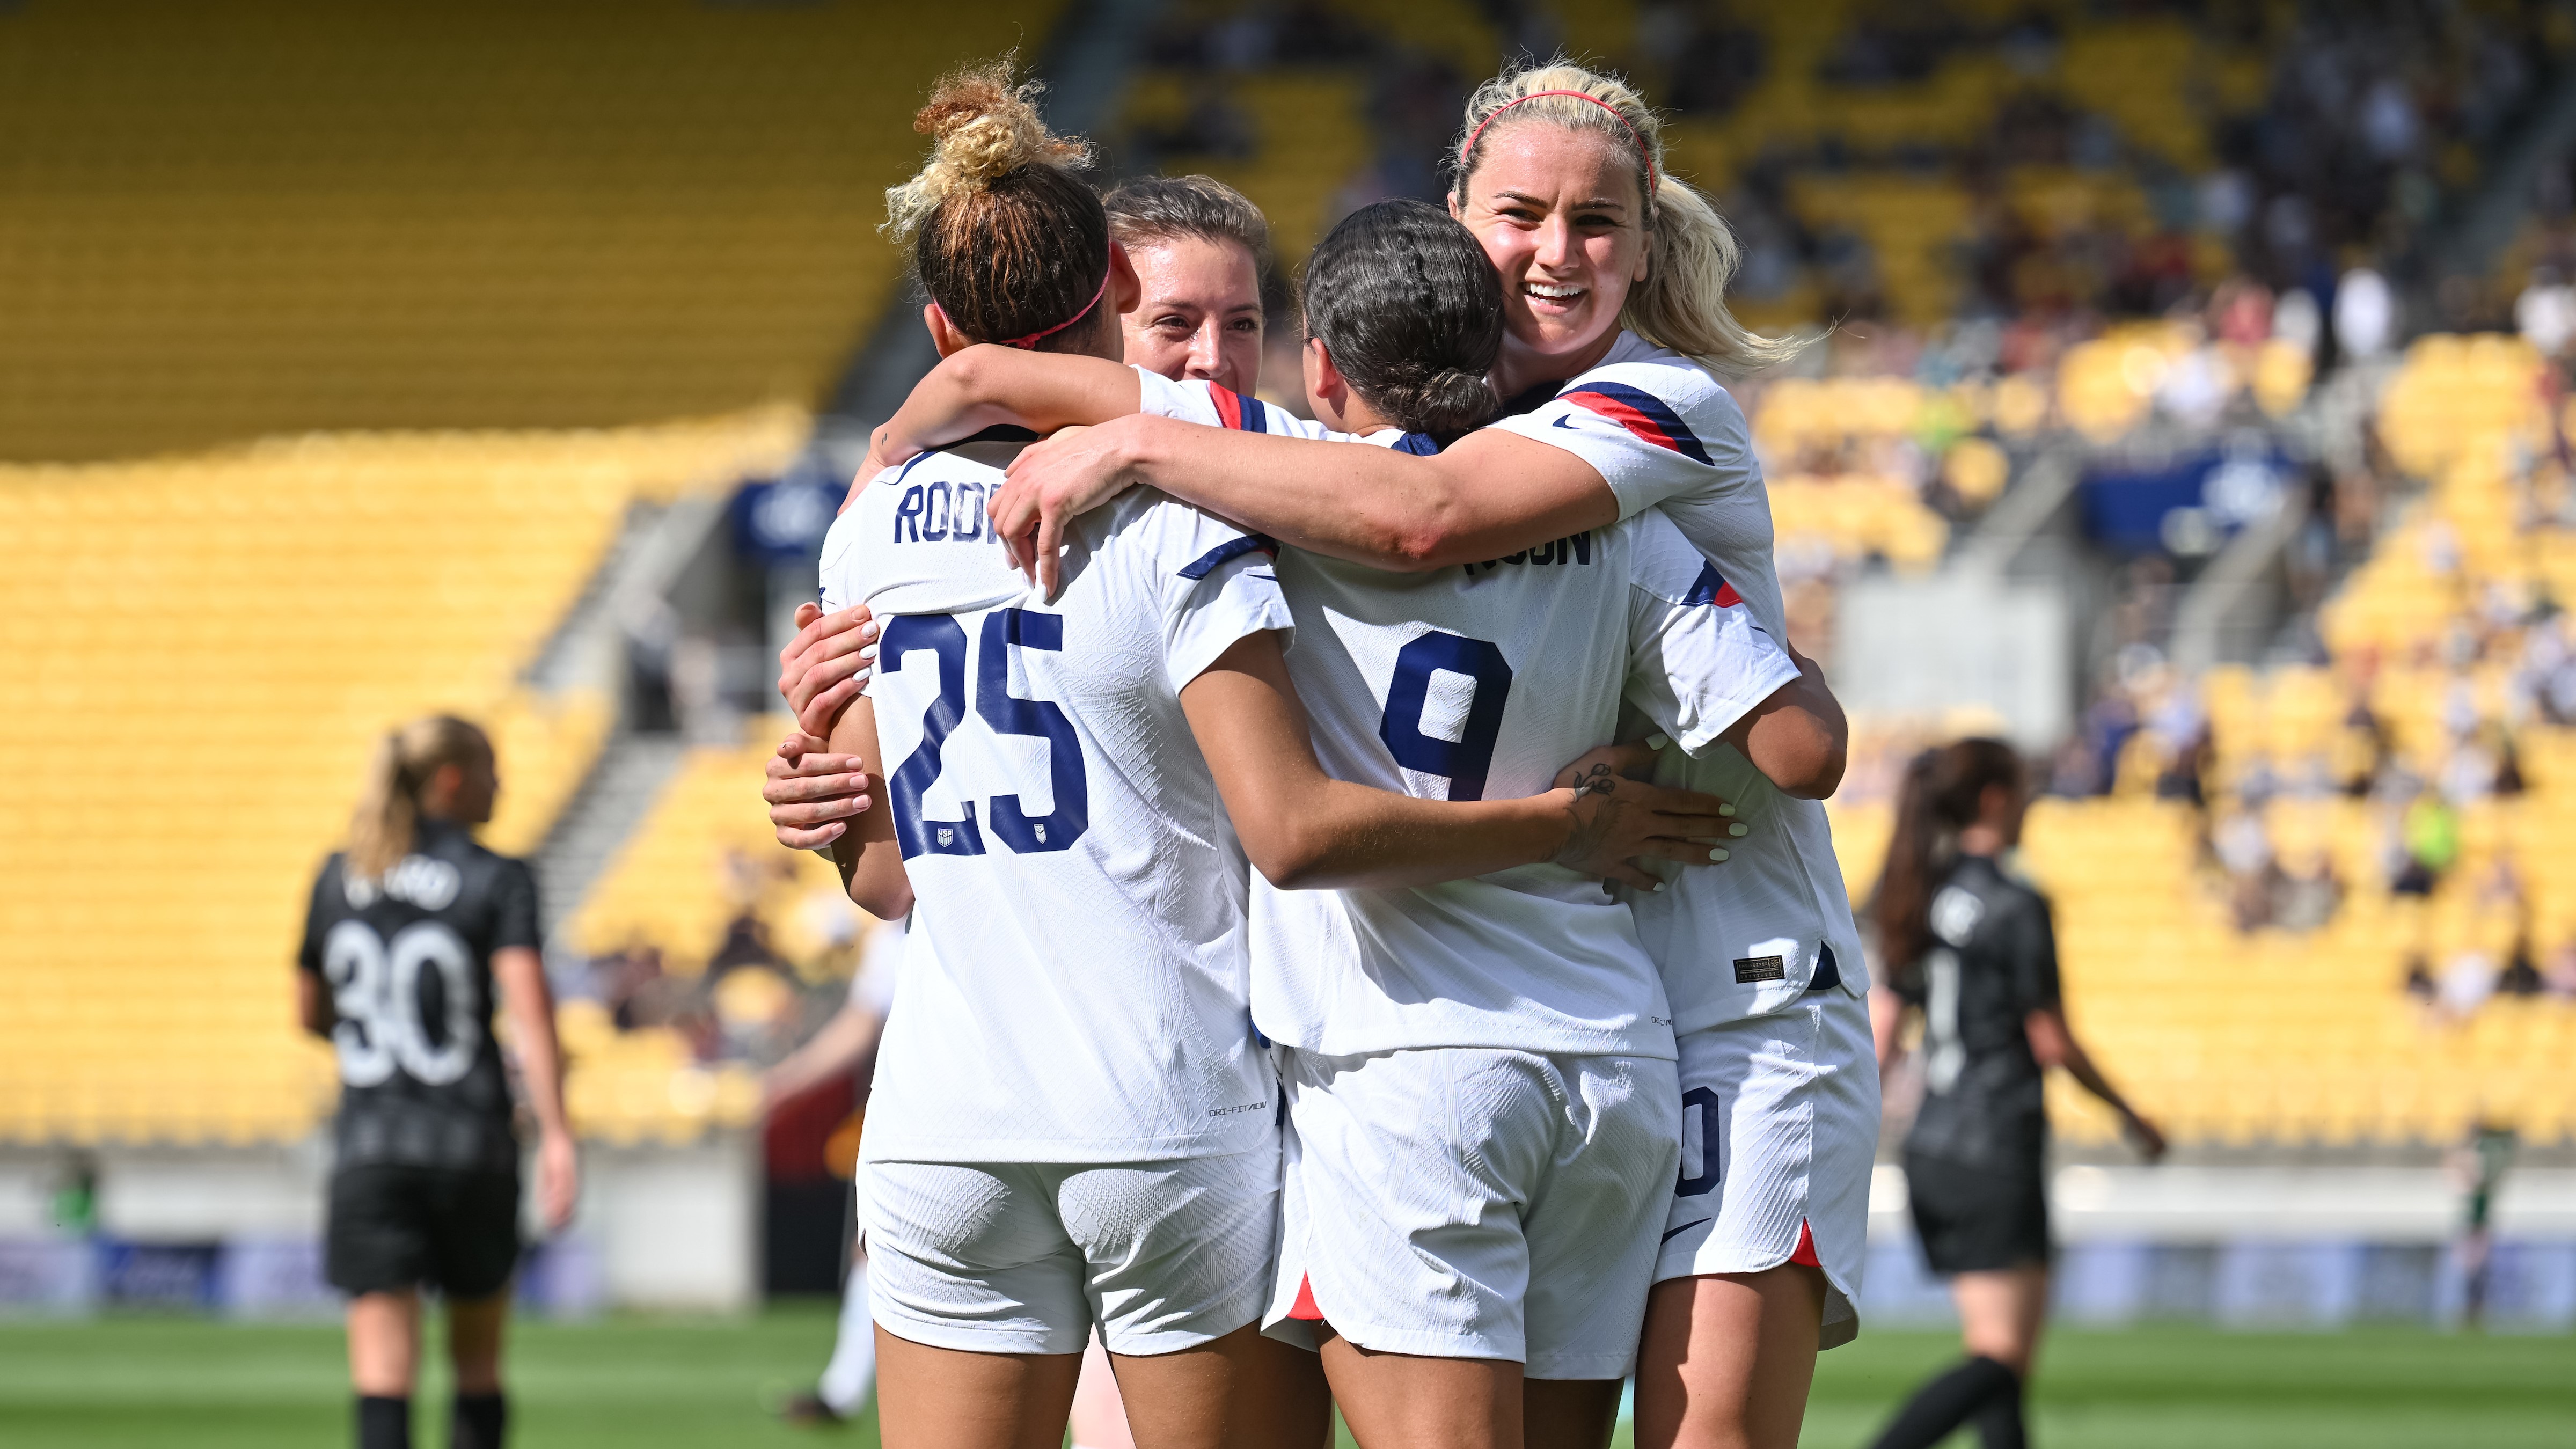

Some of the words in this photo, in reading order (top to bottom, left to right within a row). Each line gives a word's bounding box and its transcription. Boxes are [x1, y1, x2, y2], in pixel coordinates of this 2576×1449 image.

[894, 481, 1001, 544] ROD
[880, 608, 1088, 862] 25
[1379, 630, 1513, 801] 9
[324, 919, 478, 1087] 30
